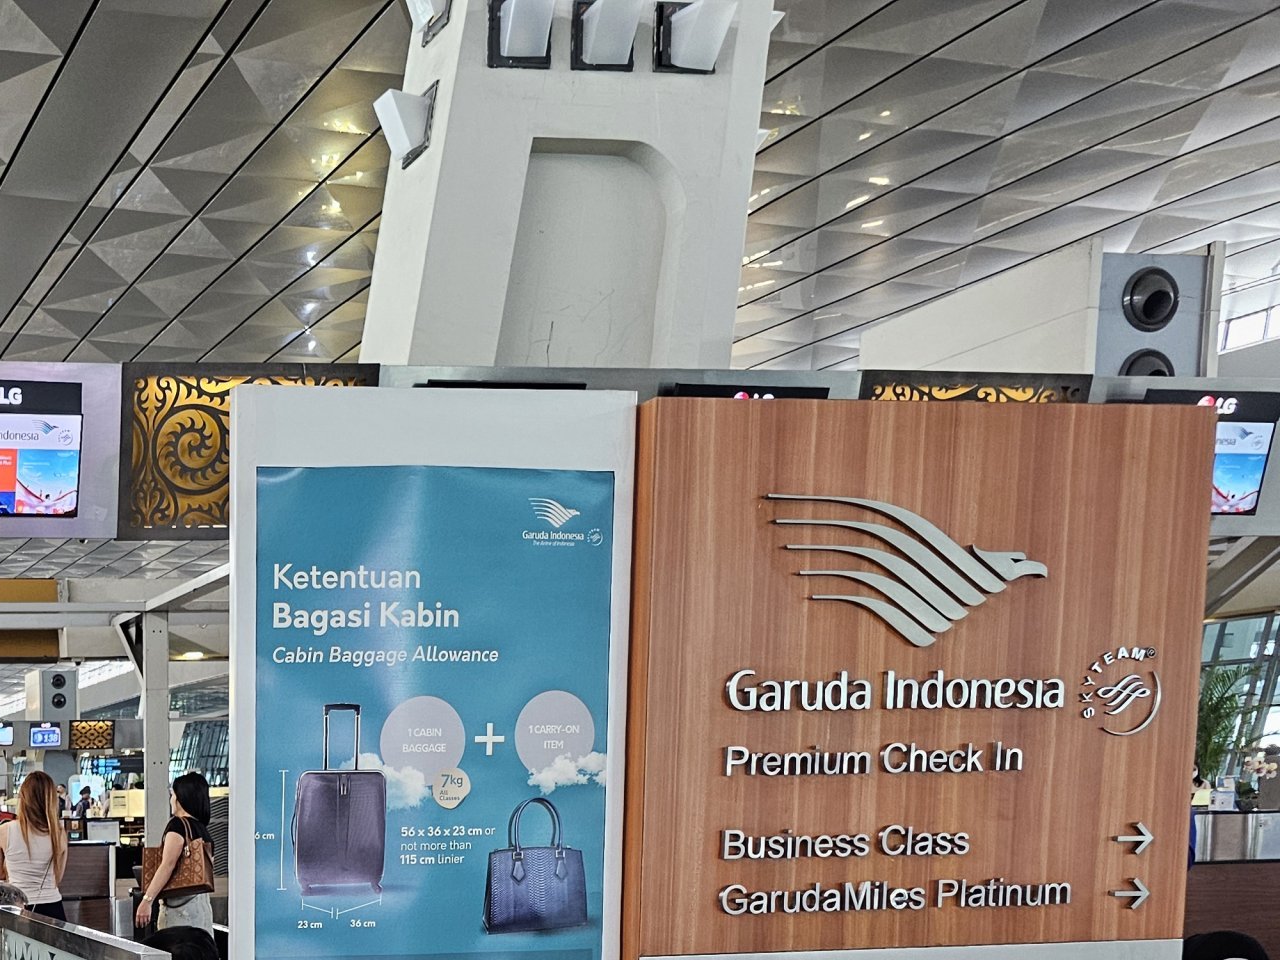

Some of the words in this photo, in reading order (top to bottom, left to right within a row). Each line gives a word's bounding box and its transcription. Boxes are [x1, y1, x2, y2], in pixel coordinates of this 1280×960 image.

[522, 530, 549, 540] Garuda
[550, 531, 584, 541] Indonesia
[273, 563, 421, 590] Ketentuan
[272, 601, 370, 636] Bagasi
[379, 601, 459, 629] Kabin
[272, 646, 324, 664] Cabin
[329, 646, 408, 667] Baggage
[412, 645, 499, 662] Allowance
[727, 669, 872, 712] Garuda
[884, 669, 1066, 711] Indonesia
[413, 728, 442, 737] CABIN
[534, 724, 580, 735] CARRY-ON
[402, 743, 447, 753] BAGGAGE
[543, 740, 564, 750] ITEM
[724, 745, 871, 777] Premium
[881, 742, 984, 776] Check
[994, 741, 1024, 772] In
[440, 773, 464, 788] 7kg
[401, 827, 416, 837] 56
[417, 829, 425, 837] x
[427, 826, 441, 837] 36
[443, 829, 451, 837] x
[452, 826, 466, 836] 23
[467, 828, 483, 836] cm
[484, 828, 496, 836] or
[400, 841, 418, 851] not
[420, 842, 448, 851] more
[449, 840, 472, 850] than
[722, 829, 870, 862] Business
[878, 825, 971, 857] Class
[400, 855, 417, 865] 115
[420, 857, 435, 865] cm
[437, 854, 465, 864] linier
[720, 881, 927, 916] GarudaMiles
[937, 877, 1073, 909] Platinum
[297, 920, 309, 929] 23
[310, 921, 323, 929] cm
[350, 919, 362, 928] 36
[363, 920, 376, 928] cm
